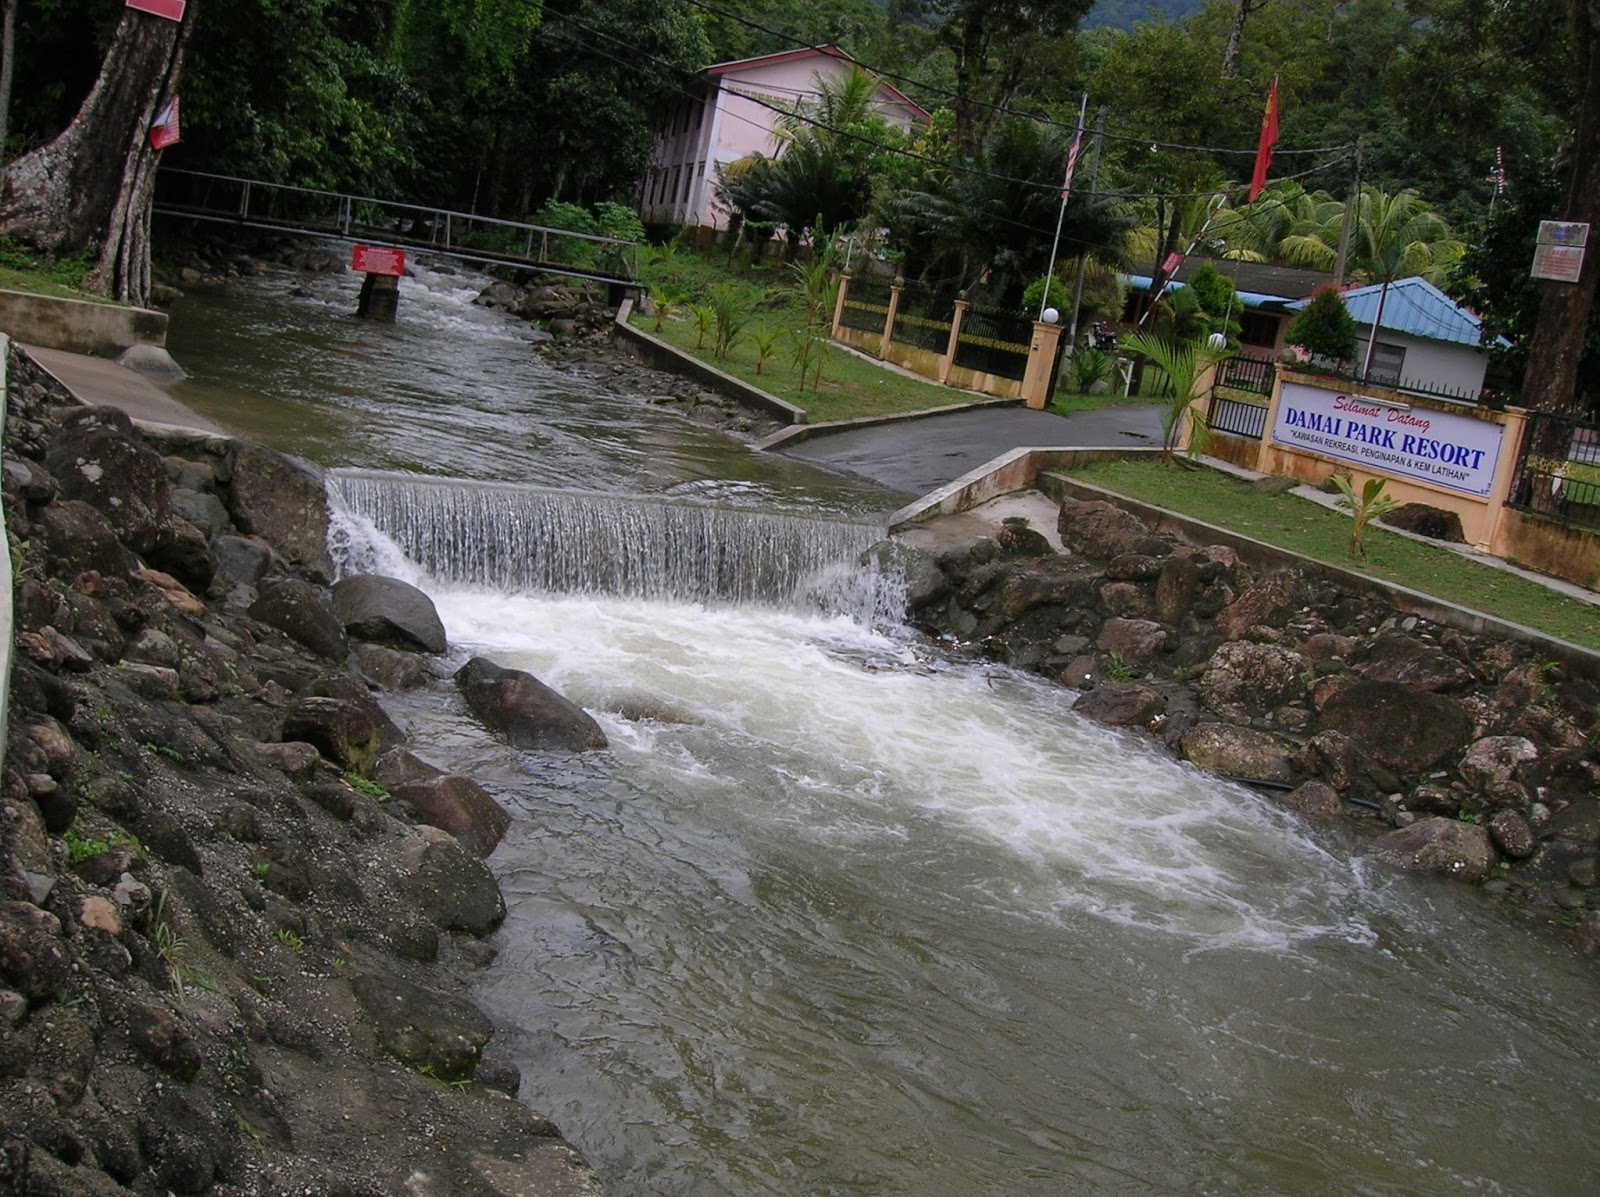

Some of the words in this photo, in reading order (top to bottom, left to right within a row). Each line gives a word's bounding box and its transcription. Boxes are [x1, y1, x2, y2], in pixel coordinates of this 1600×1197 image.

[1333, 395, 1381, 417] Selamat
[1387, 407, 1431, 434] Datang
[1285, 407, 1342, 436] DAMAI
[1345, 420, 1398, 450] PARK
[1401, 434, 1486, 470] RESORT
[1360, 447, 1406, 465] PENGINAPAN
[1406, 458, 1413, 467] &
[1413, 461, 1430, 472] KEM
